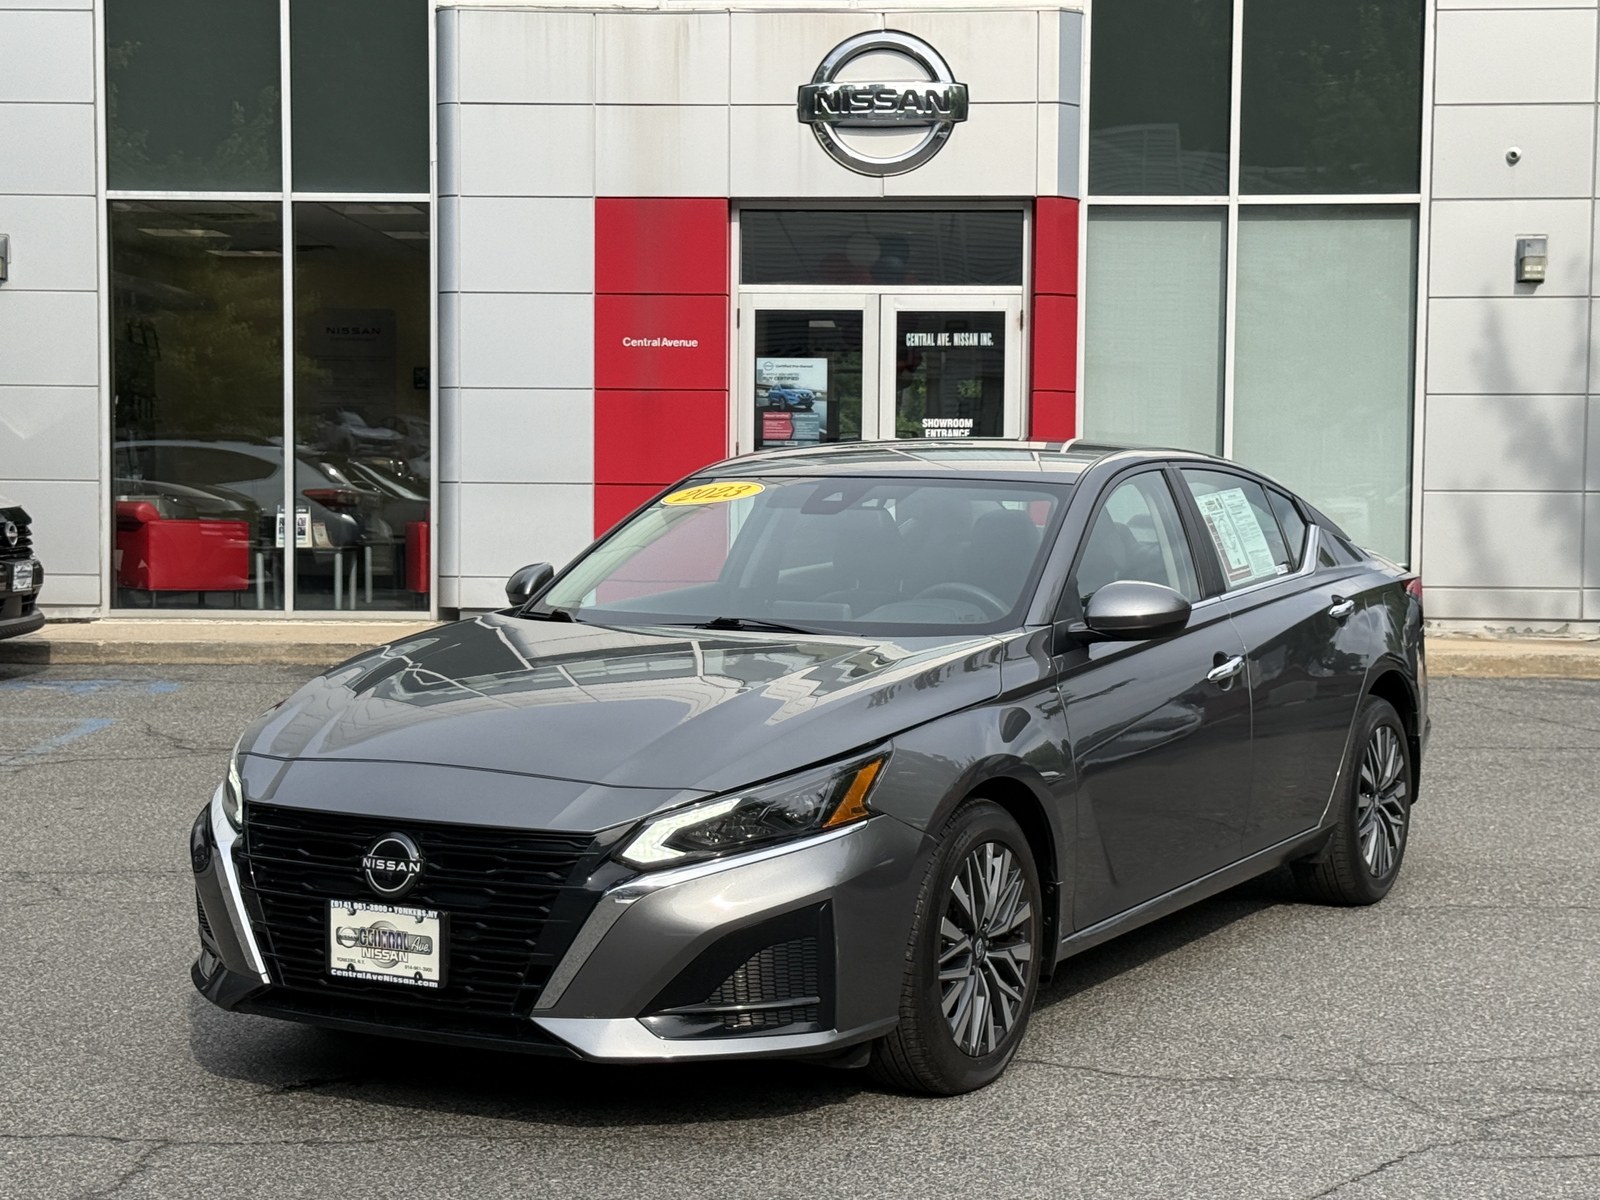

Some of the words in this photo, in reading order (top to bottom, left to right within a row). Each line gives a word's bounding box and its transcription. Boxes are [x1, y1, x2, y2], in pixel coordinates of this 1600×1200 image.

[814, 88, 951, 115] NISSAN
[326, 327, 380, 335] NISSAN
[622, 336, 660, 347] Central
[661, 337, 699, 347] Avenue
[905, 333, 935, 346] CENTRAL
[936, 333, 952, 346] AVE.
[953, 332, 978, 346] NISSAN
[980, 332, 994, 346] INC.
[922, 418, 973, 428] SHOWROOM
[925, 428, 970, 438] ENTRANCE
[672, 485, 752, 502] 2023
[362, 857, 420, 872] NISSAN
[359, 927, 409, 950] CENTRAL
[411, 936, 431, 952] Ave.
[361, 948, 408, 963] NISSAN
[331, 969, 438, 988] CentralAveNissan.com
